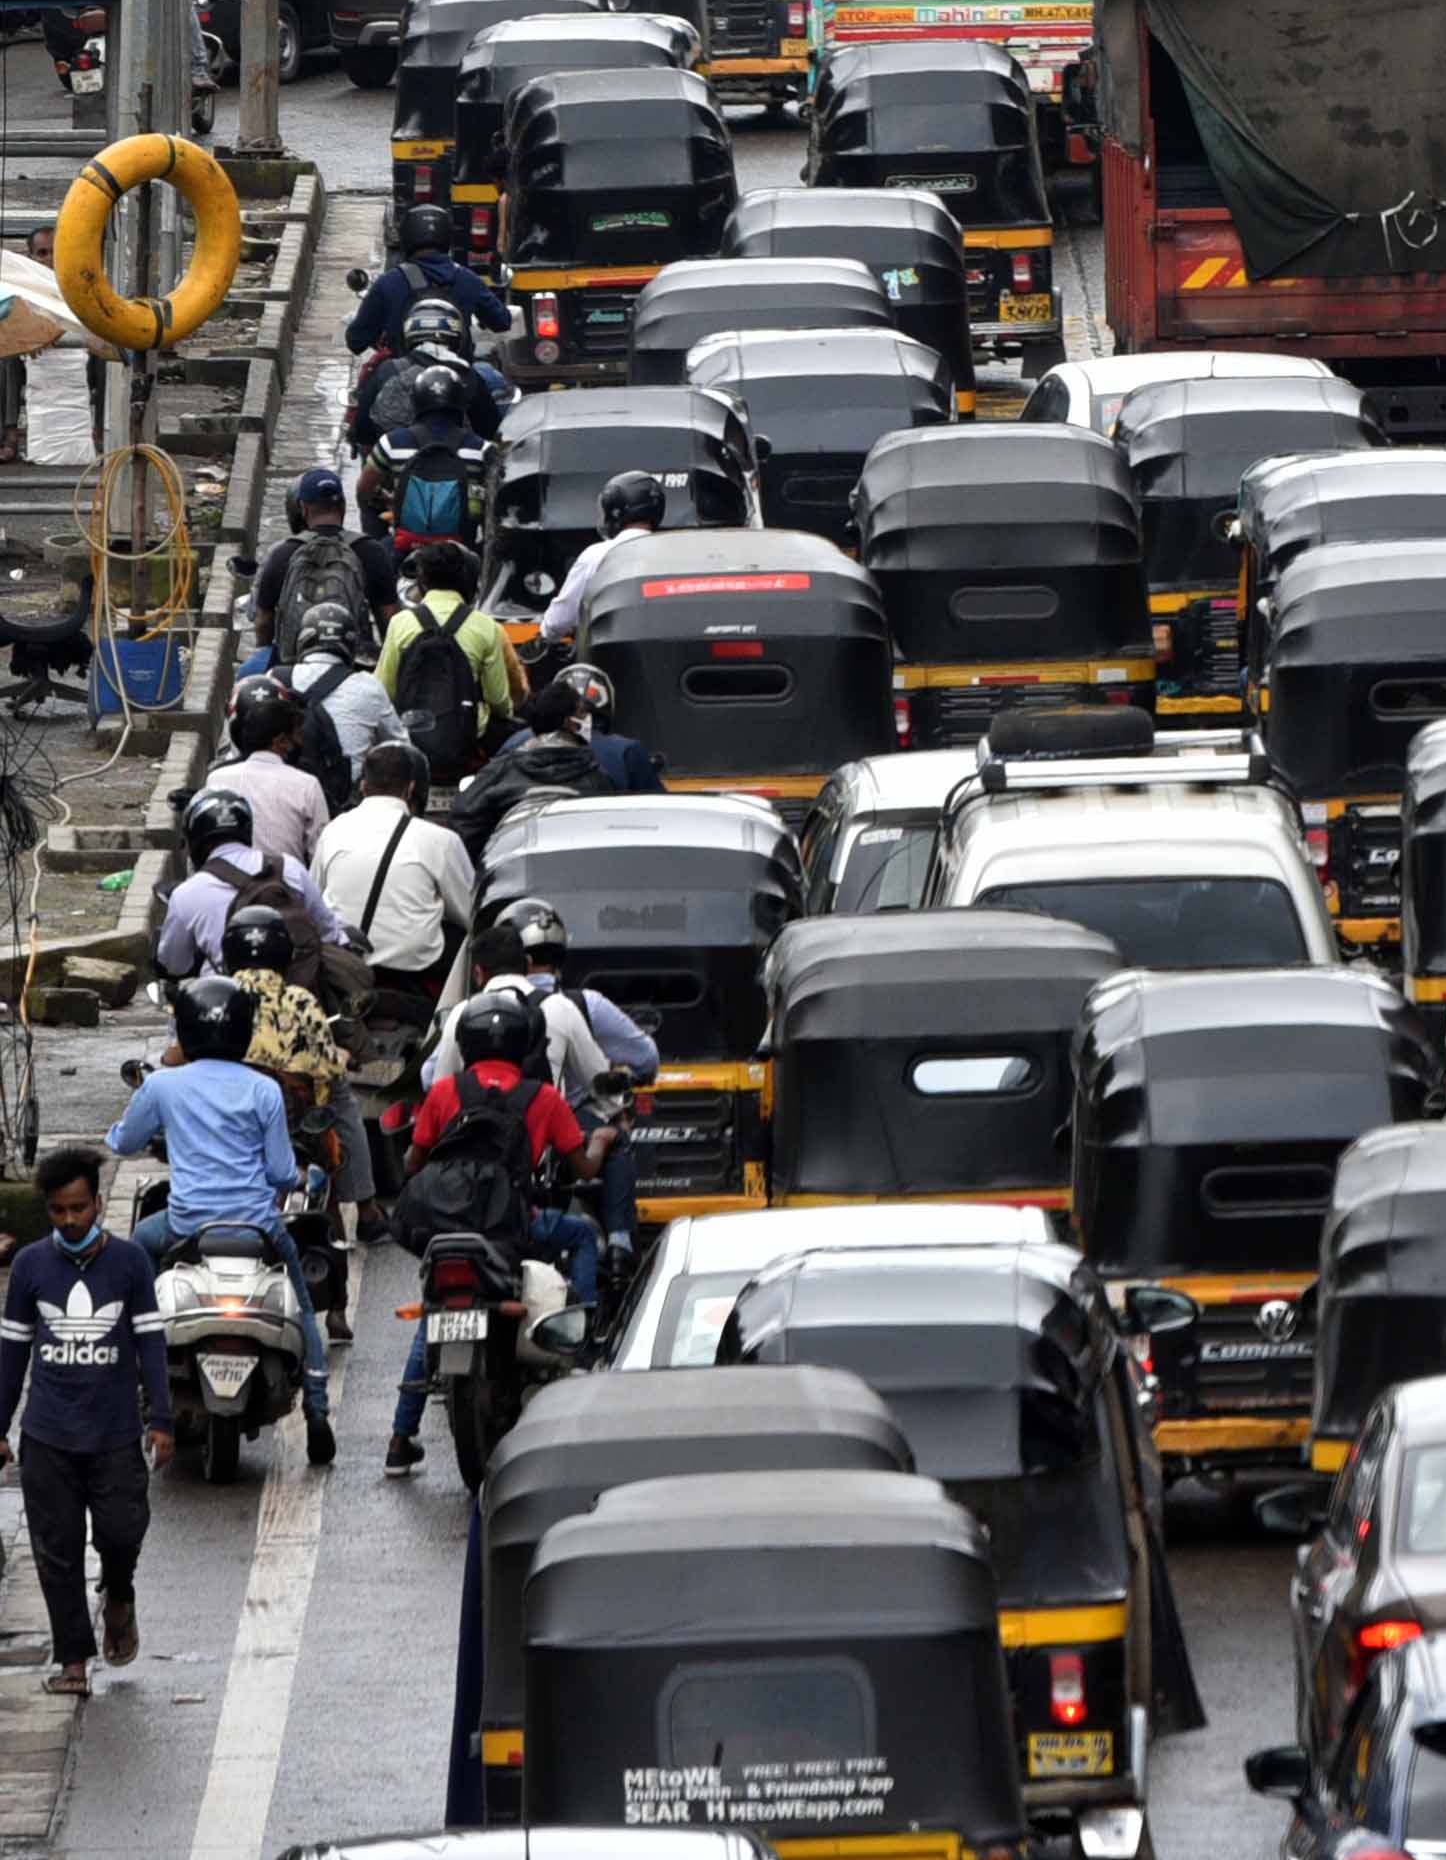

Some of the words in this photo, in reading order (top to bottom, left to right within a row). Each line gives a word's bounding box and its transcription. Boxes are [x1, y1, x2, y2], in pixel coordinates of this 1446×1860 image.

[837, 10, 875, 22] STOP
[40, 1342, 118, 1366] adidas
[860, 1776, 894, 1794] App
